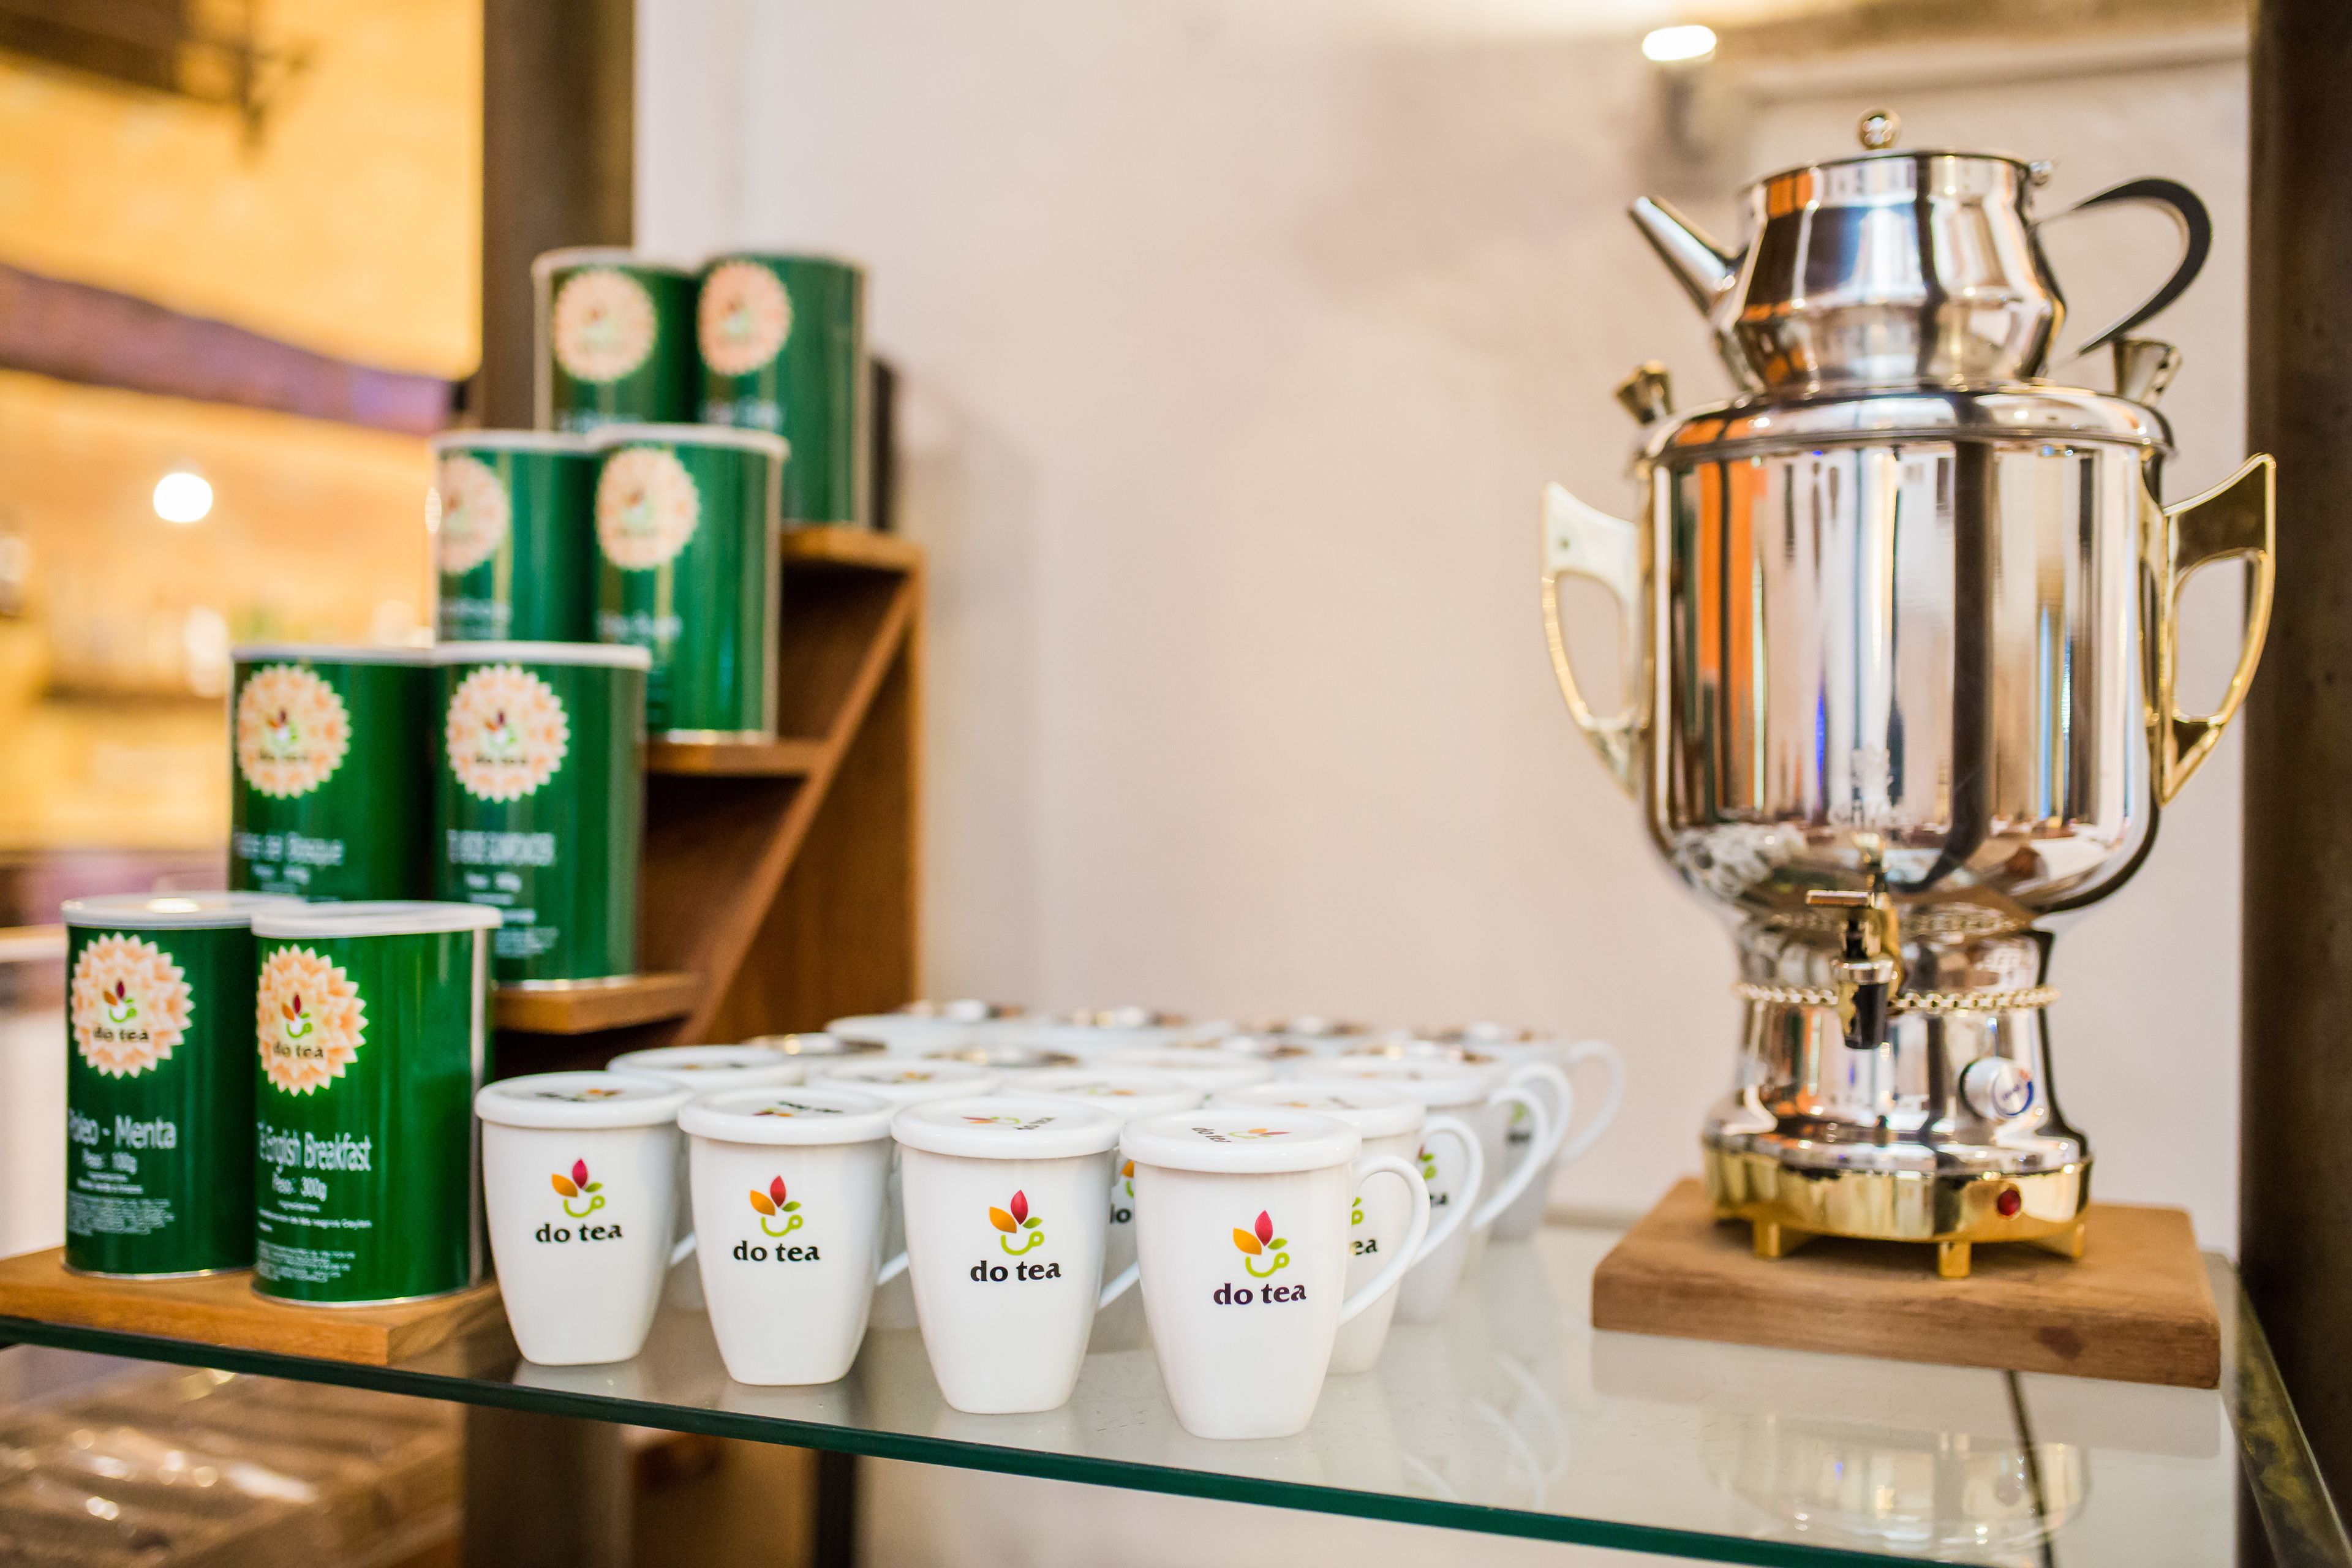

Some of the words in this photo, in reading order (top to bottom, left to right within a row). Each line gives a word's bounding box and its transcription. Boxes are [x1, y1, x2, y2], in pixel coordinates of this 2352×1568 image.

[115, 1114, 176, 1150] Menta
[304, 1132, 372, 1171] Breakfast
[535, 1223, 571, 1243] do
[579, 1224, 622, 1242] tea
[733, 1240, 767, 1261] do
[775, 1243, 820, 1262] tea
[1351, 1239, 1378, 1255] ea
[970, 1260, 1009, 1282] do
[1016, 1261, 1061, 1281] tea
[1213, 1283, 1254, 1305] do
[1261, 1284, 1306, 1303] tea
